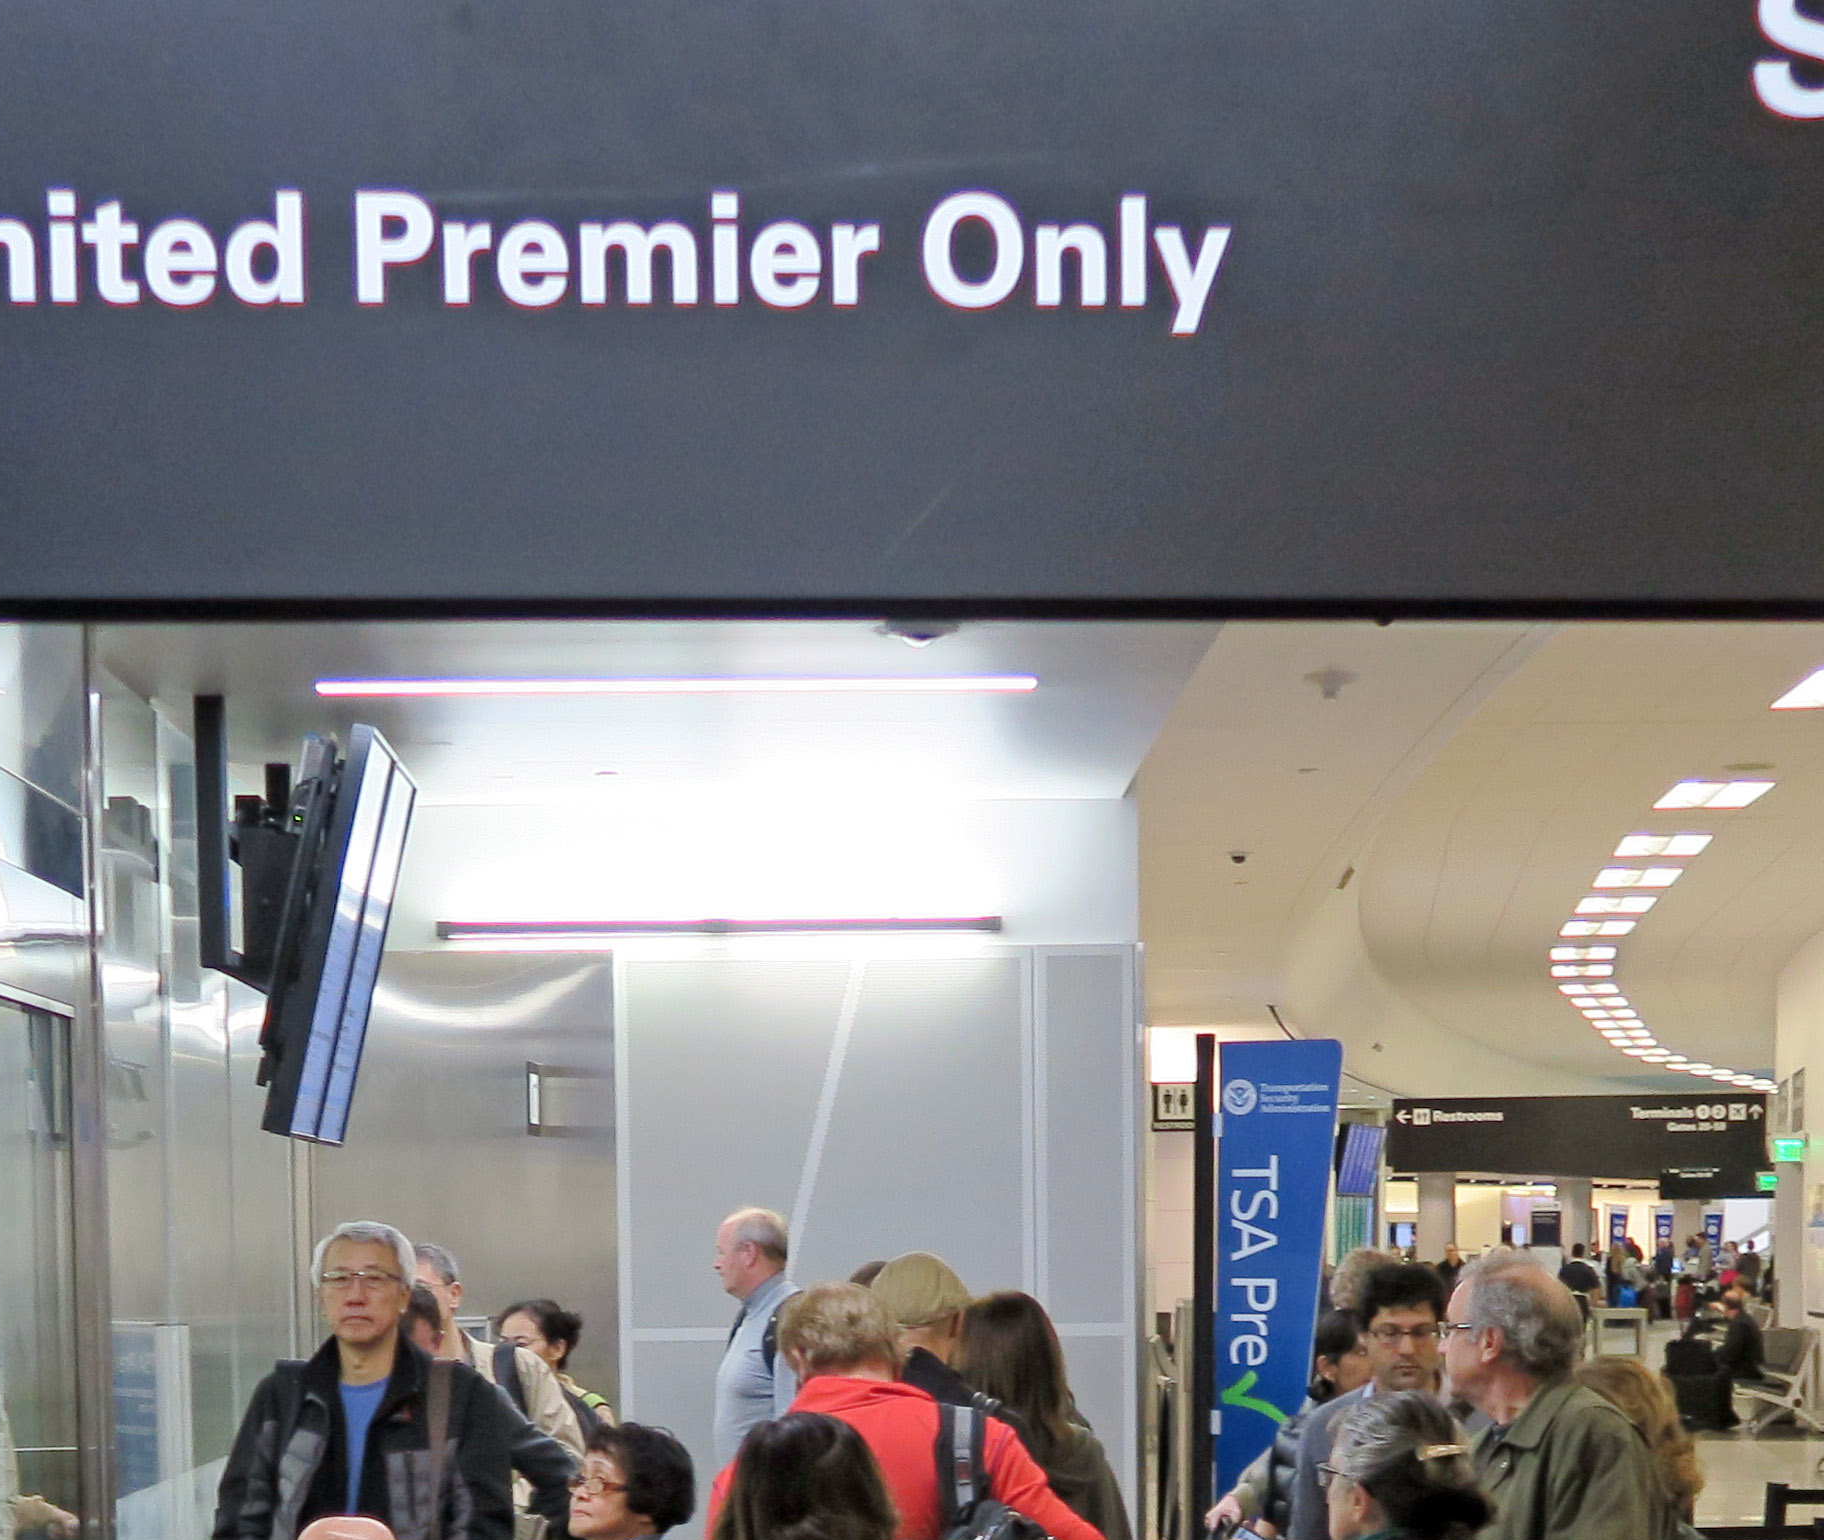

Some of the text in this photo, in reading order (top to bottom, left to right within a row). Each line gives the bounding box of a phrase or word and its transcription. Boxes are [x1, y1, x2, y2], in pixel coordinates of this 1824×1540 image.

[353, 189, 880, 308] Premier
[921, 191, 1233, 334] Only
[1432, 1110, 1504, 1122] Restrooms
[1229, 1154, 1279, 1367] TSA Pre
